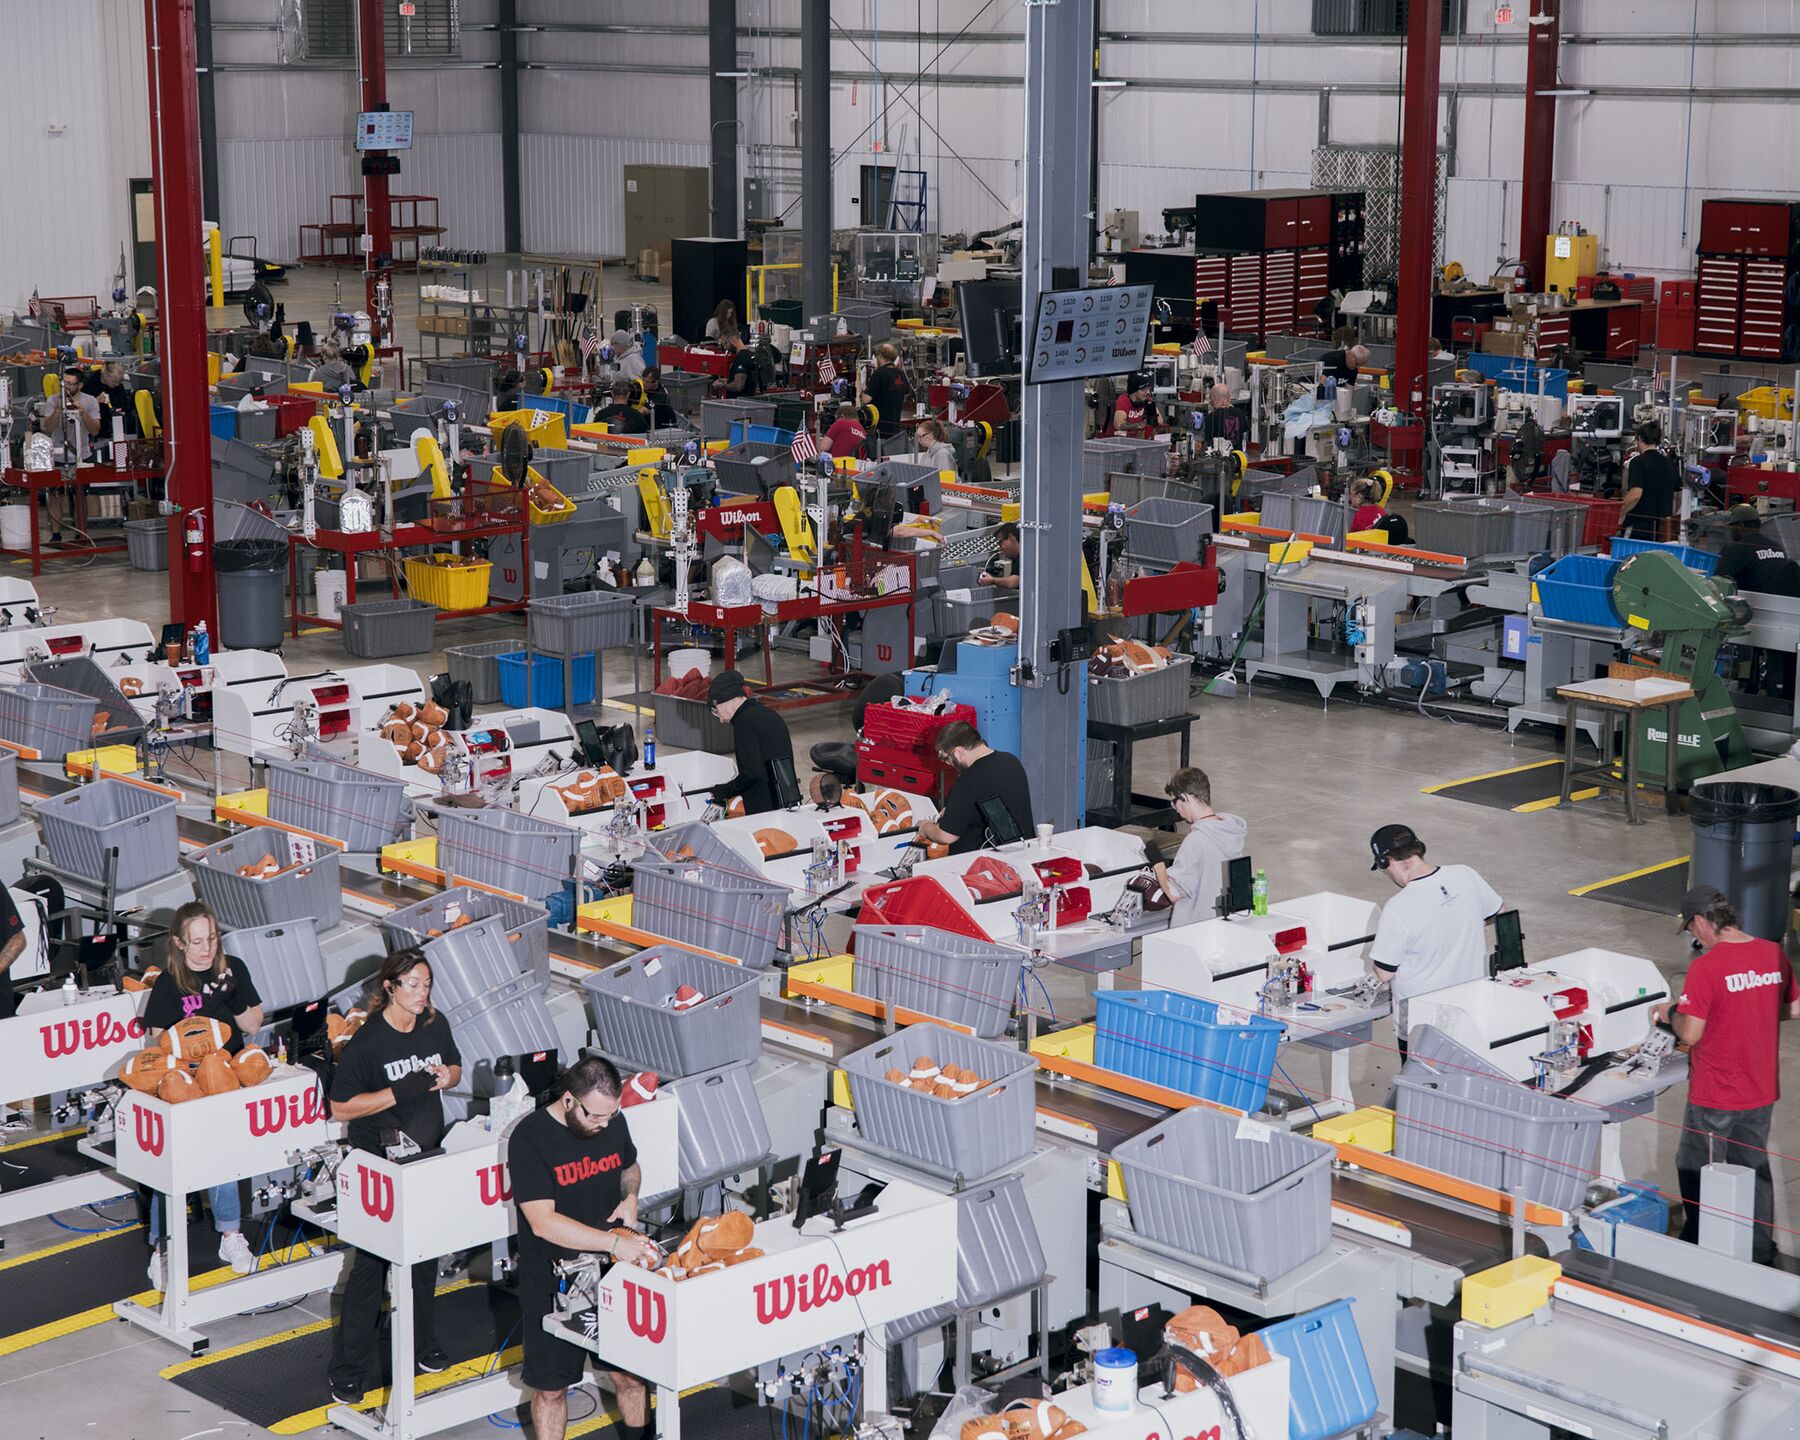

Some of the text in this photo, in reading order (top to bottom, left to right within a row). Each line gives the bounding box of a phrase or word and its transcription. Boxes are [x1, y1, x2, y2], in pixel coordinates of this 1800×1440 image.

[1112, 347, 1137, 358] Wilson
[720, 510, 762, 526] Wilson
[877, 643, 892, 662] W
[1647, 727, 1701, 747] ROUELLE
[1724, 969, 1783, 992] Wilson
[39, 1011, 147, 1058] Wilso
[132, 1103, 164, 1157] W
[245, 1086, 326, 1137] Wil
[554, 1152, 622, 1187] Wilson
[357, 1163, 394, 1223] W
[623, 1279, 667, 1344] W
[753, 1259, 892, 1325] Wilson
